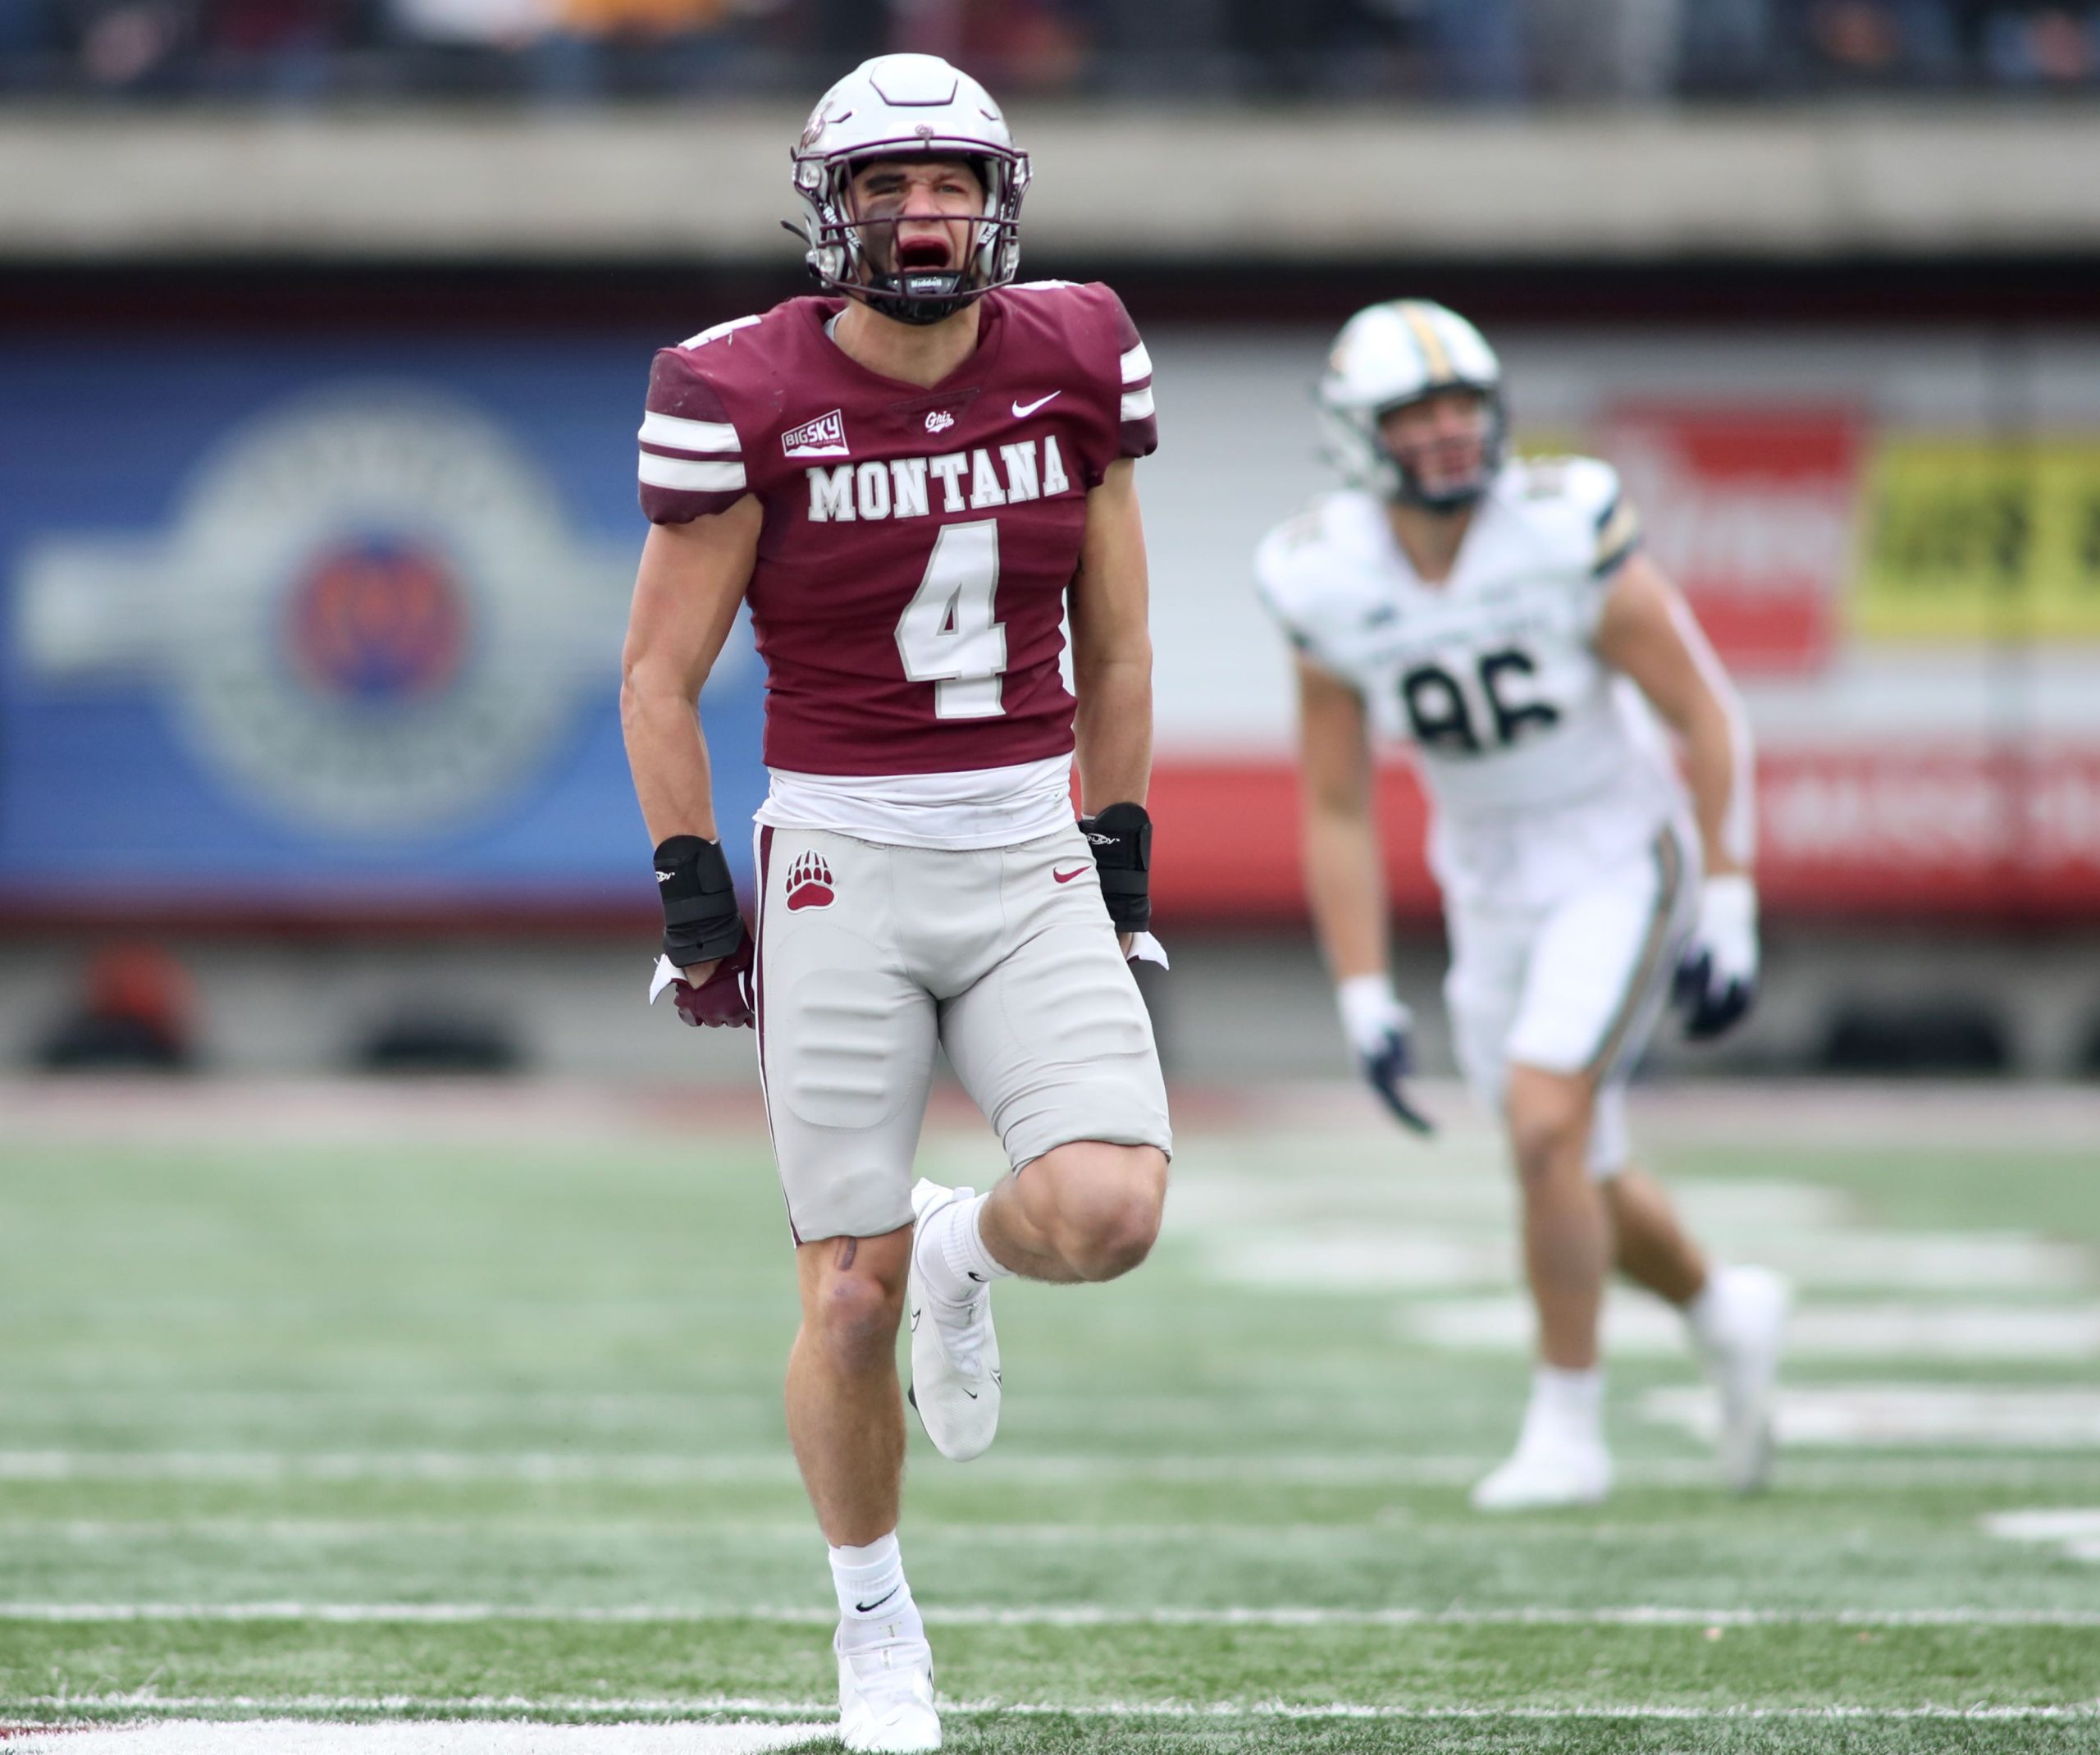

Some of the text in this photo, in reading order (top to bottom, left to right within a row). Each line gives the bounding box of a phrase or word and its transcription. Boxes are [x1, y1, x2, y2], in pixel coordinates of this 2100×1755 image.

[925, 411, 954, 431] Griz
[806, 435, 1070, 522] MONTANA
[894, 519, 1007, 720] 4
